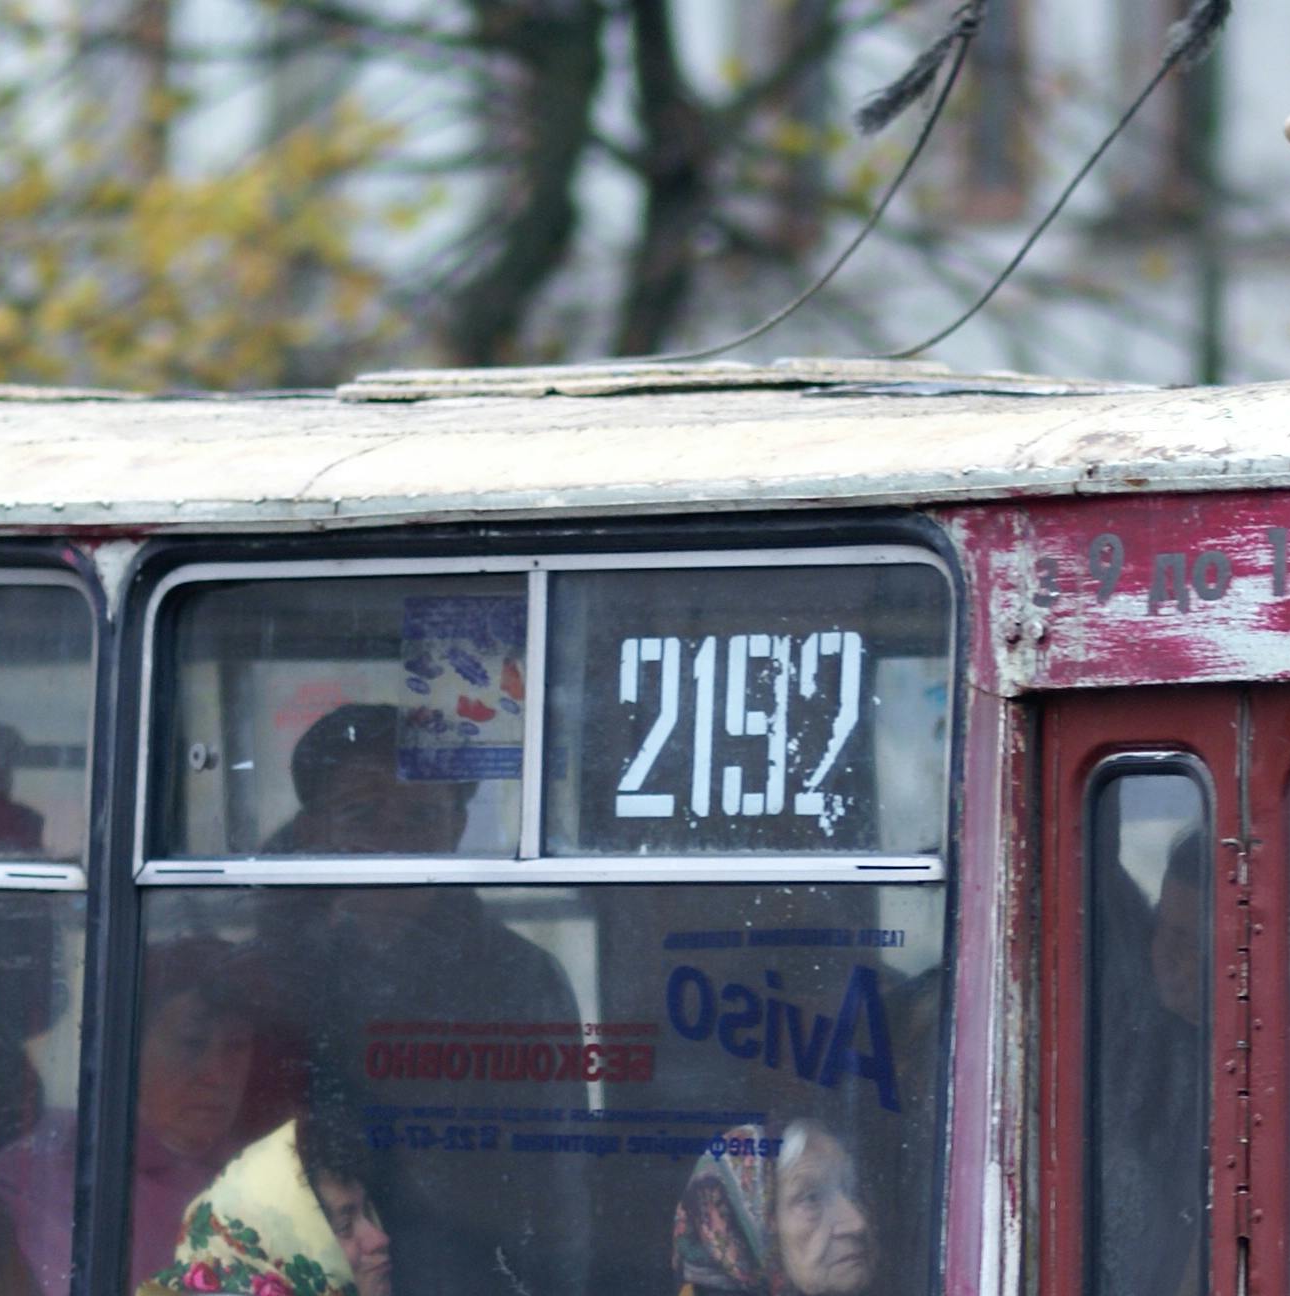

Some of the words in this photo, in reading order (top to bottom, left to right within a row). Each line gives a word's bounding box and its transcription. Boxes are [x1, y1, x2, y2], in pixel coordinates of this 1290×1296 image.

[1089, 533, 1124, 604] 9
[1148, 550, 1233, 616] до
[616, 631, 862, 818] 2192
